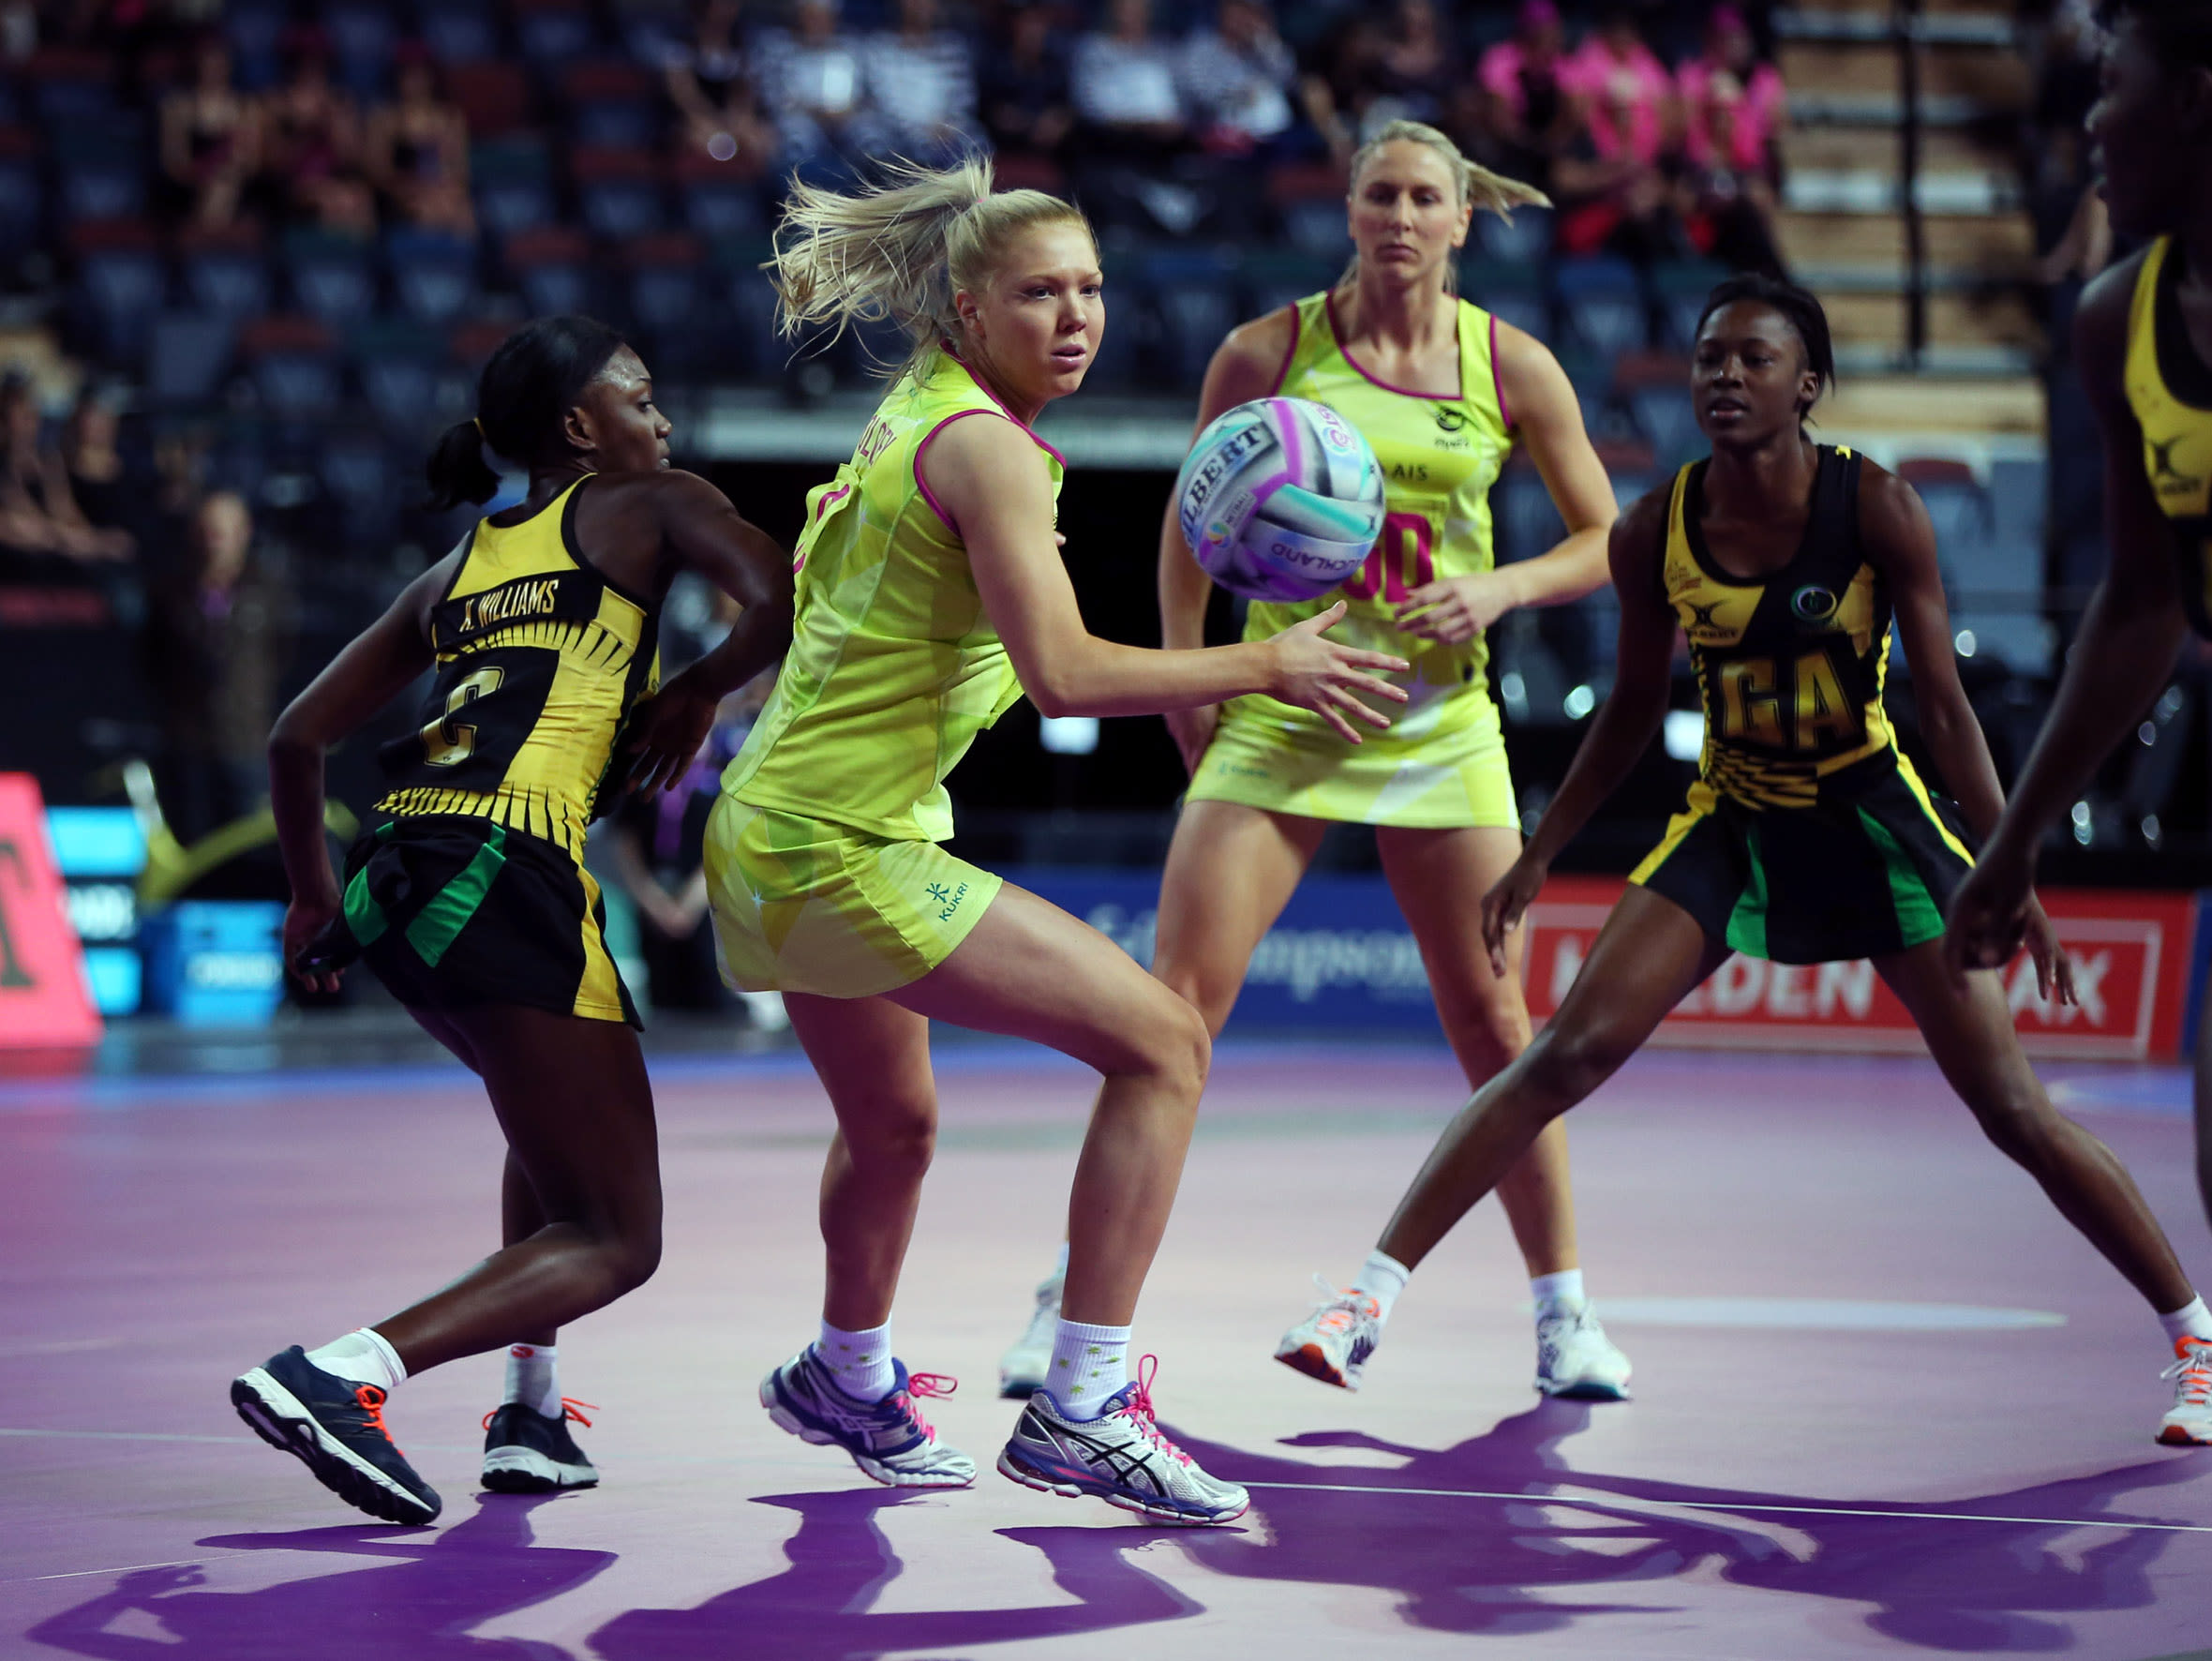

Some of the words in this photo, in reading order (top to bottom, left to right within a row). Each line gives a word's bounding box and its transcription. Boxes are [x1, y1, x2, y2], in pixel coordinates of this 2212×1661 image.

[1182, 426, 1263, 533] ILBERT
[478, 578, 560, 628] WILLIAMS
[1719, 651, 1867, 752] GA
[938, 882, 969, 922] KUKRI
